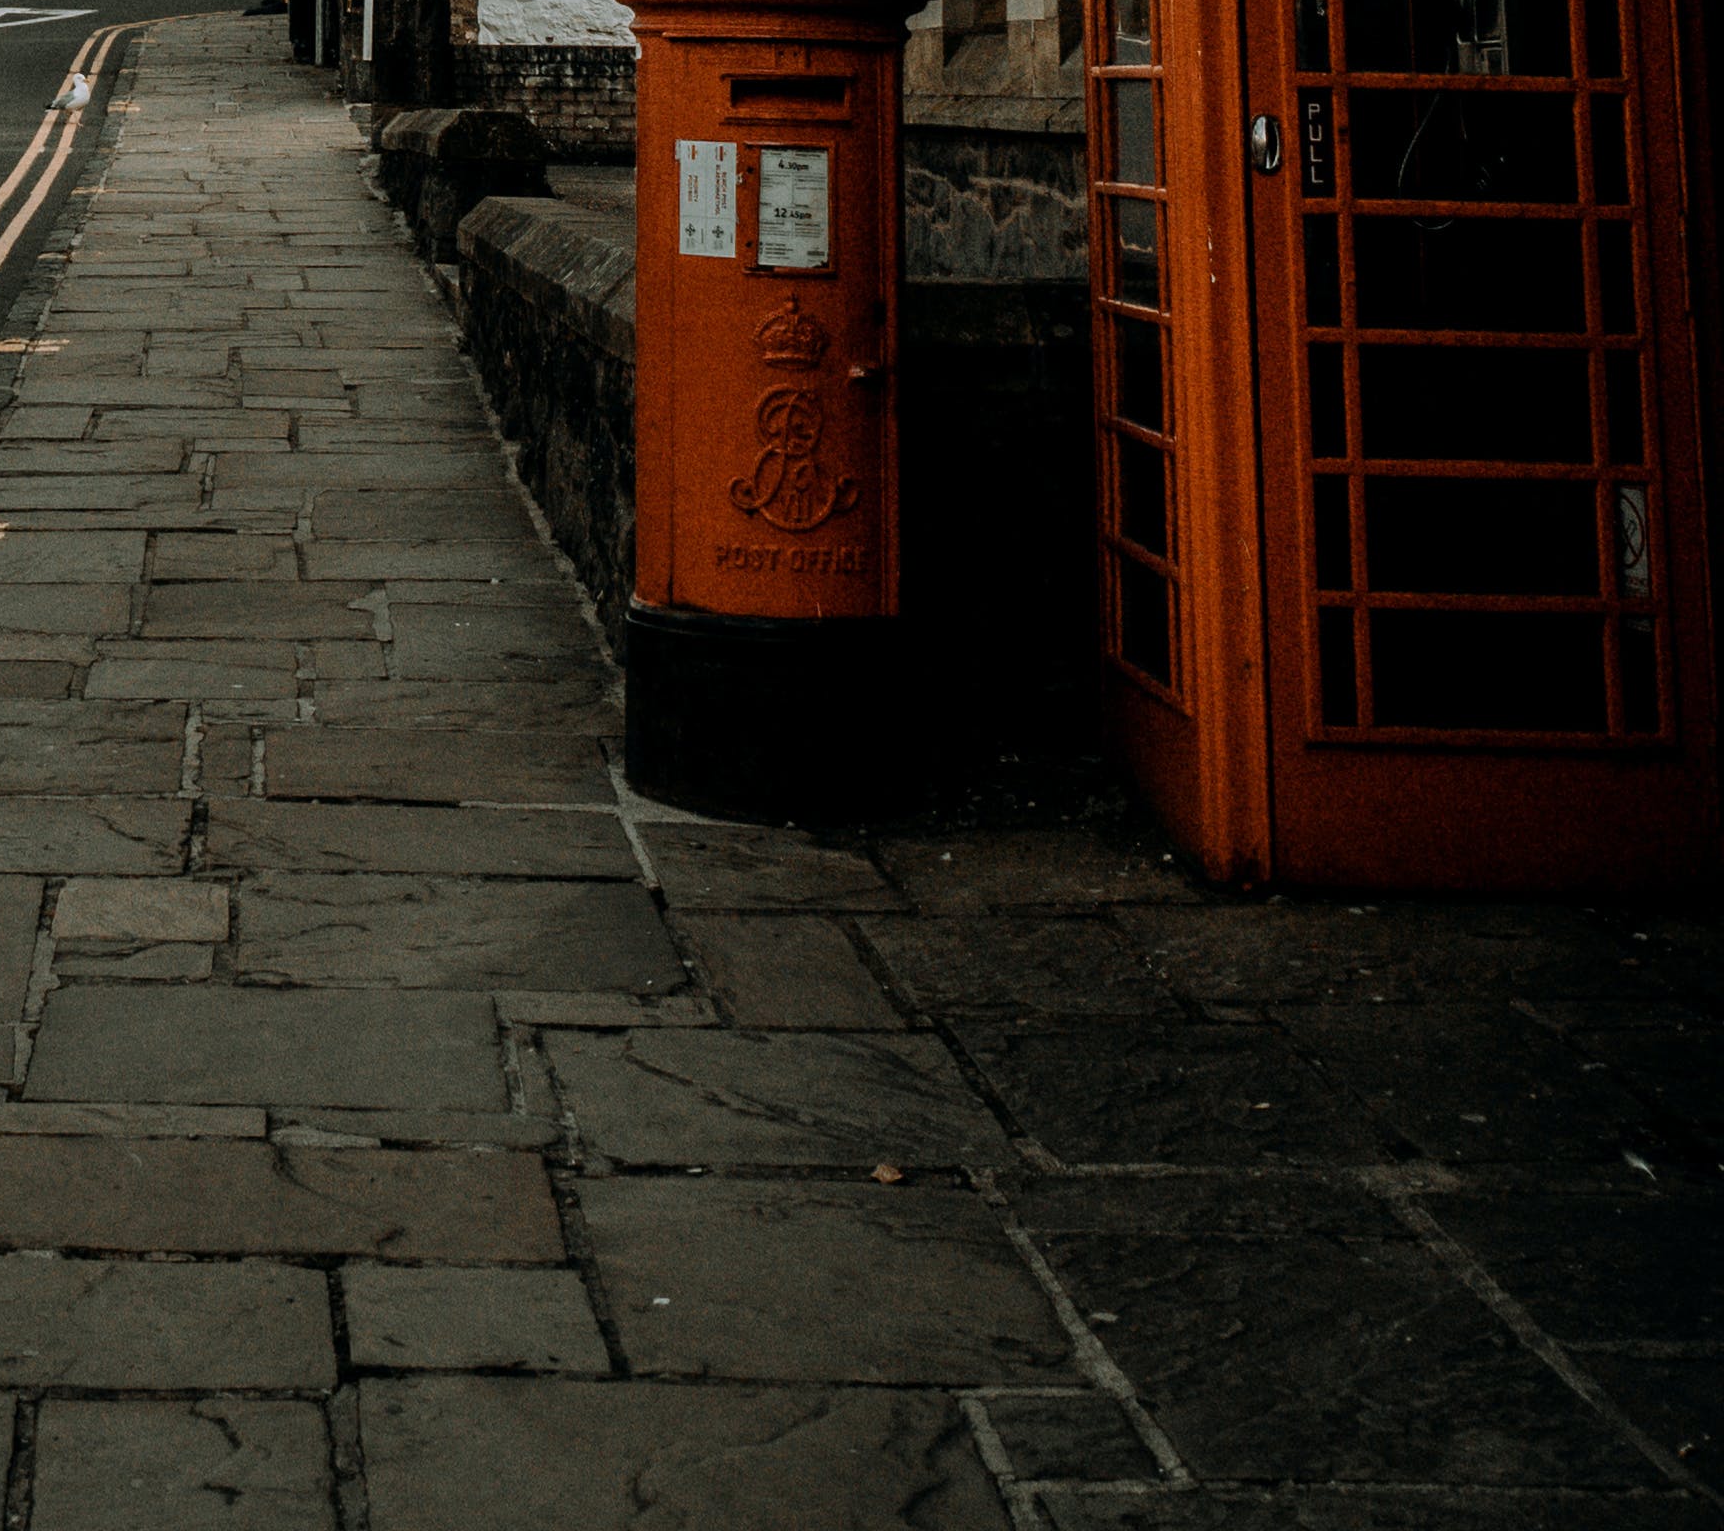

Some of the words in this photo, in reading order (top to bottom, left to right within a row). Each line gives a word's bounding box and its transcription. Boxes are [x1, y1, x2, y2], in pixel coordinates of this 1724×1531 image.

[1308, 103, 1324, 184] PULL
[716, 544, 781, 572] POST
[787, 546, 869, 575] OFFICE
